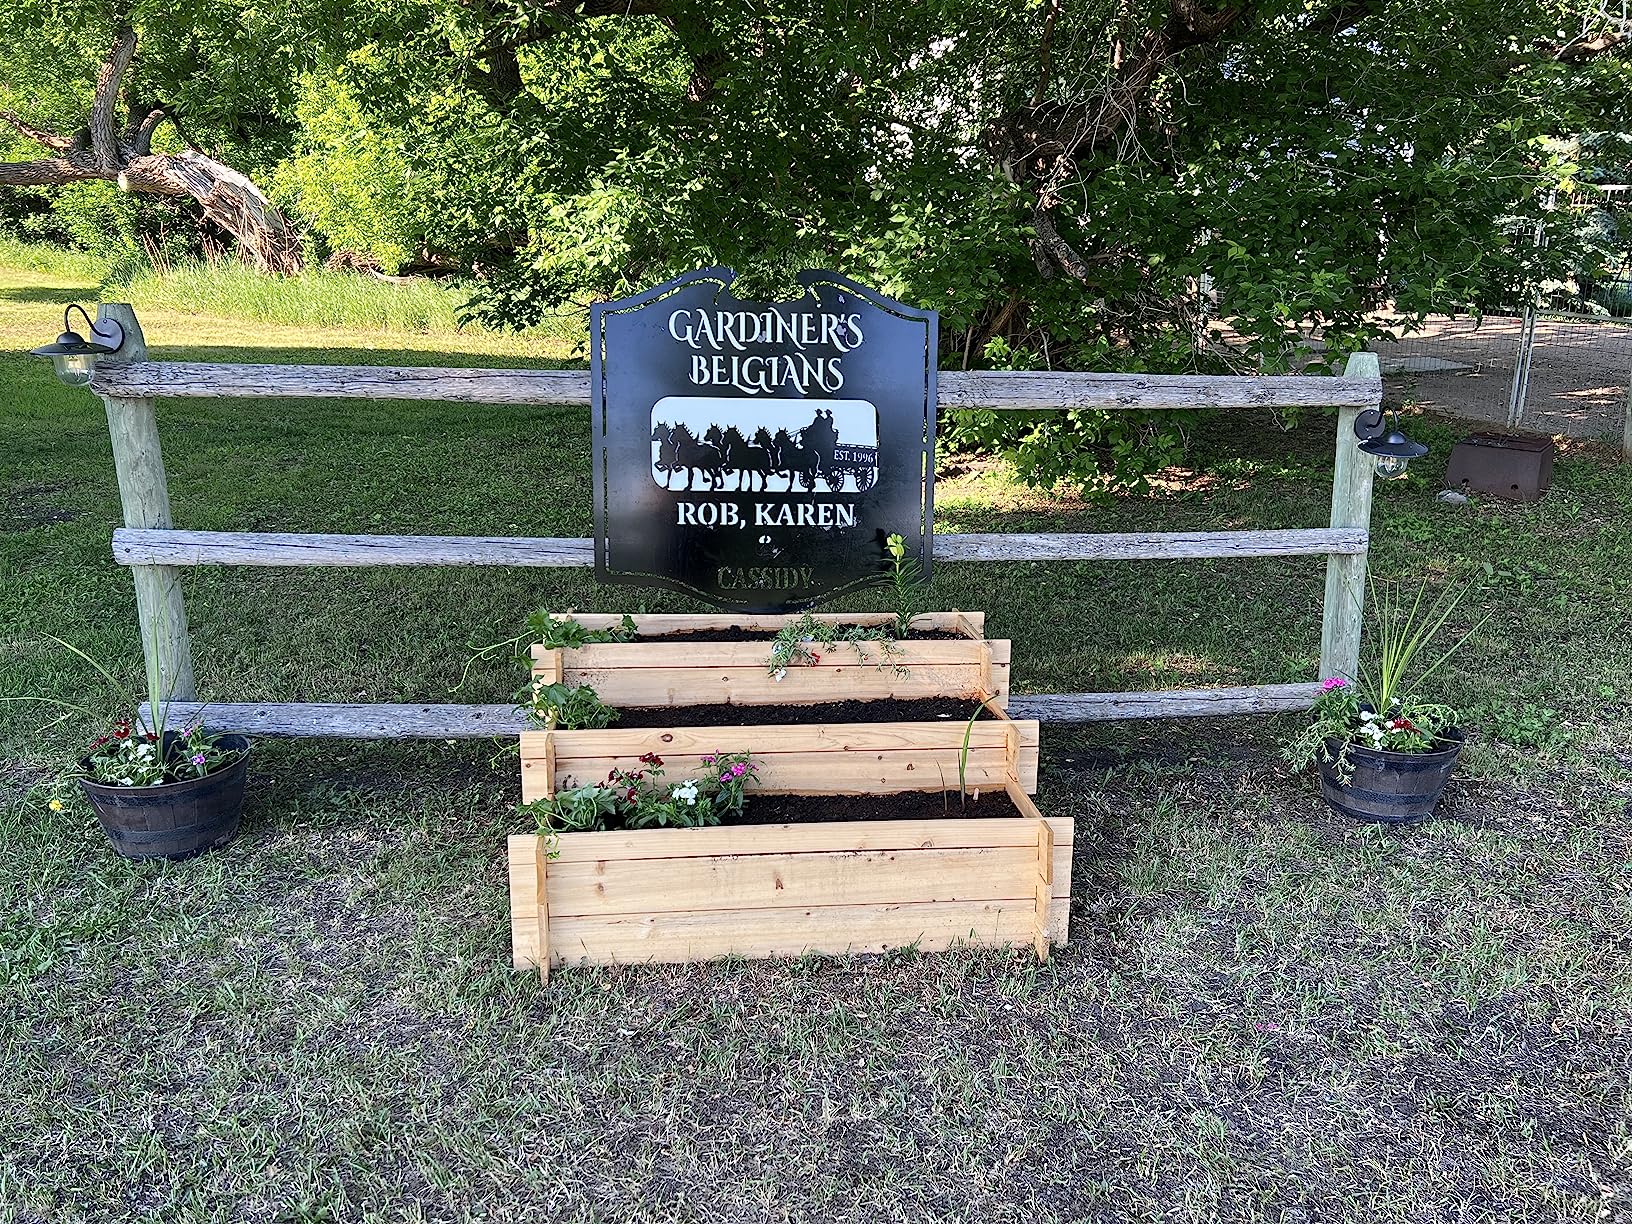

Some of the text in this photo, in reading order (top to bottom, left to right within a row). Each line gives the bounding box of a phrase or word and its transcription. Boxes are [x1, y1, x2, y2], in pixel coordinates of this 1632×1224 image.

[668, 306, 865, 353] GARDINER'S
[688, 351, 846, 395] BELGIANS
[833, 449, 875, 463] EST. 1996
[676, 502, 856, 530] ROB, KAREN
[716, 565, 816, 590] CASSIDY
